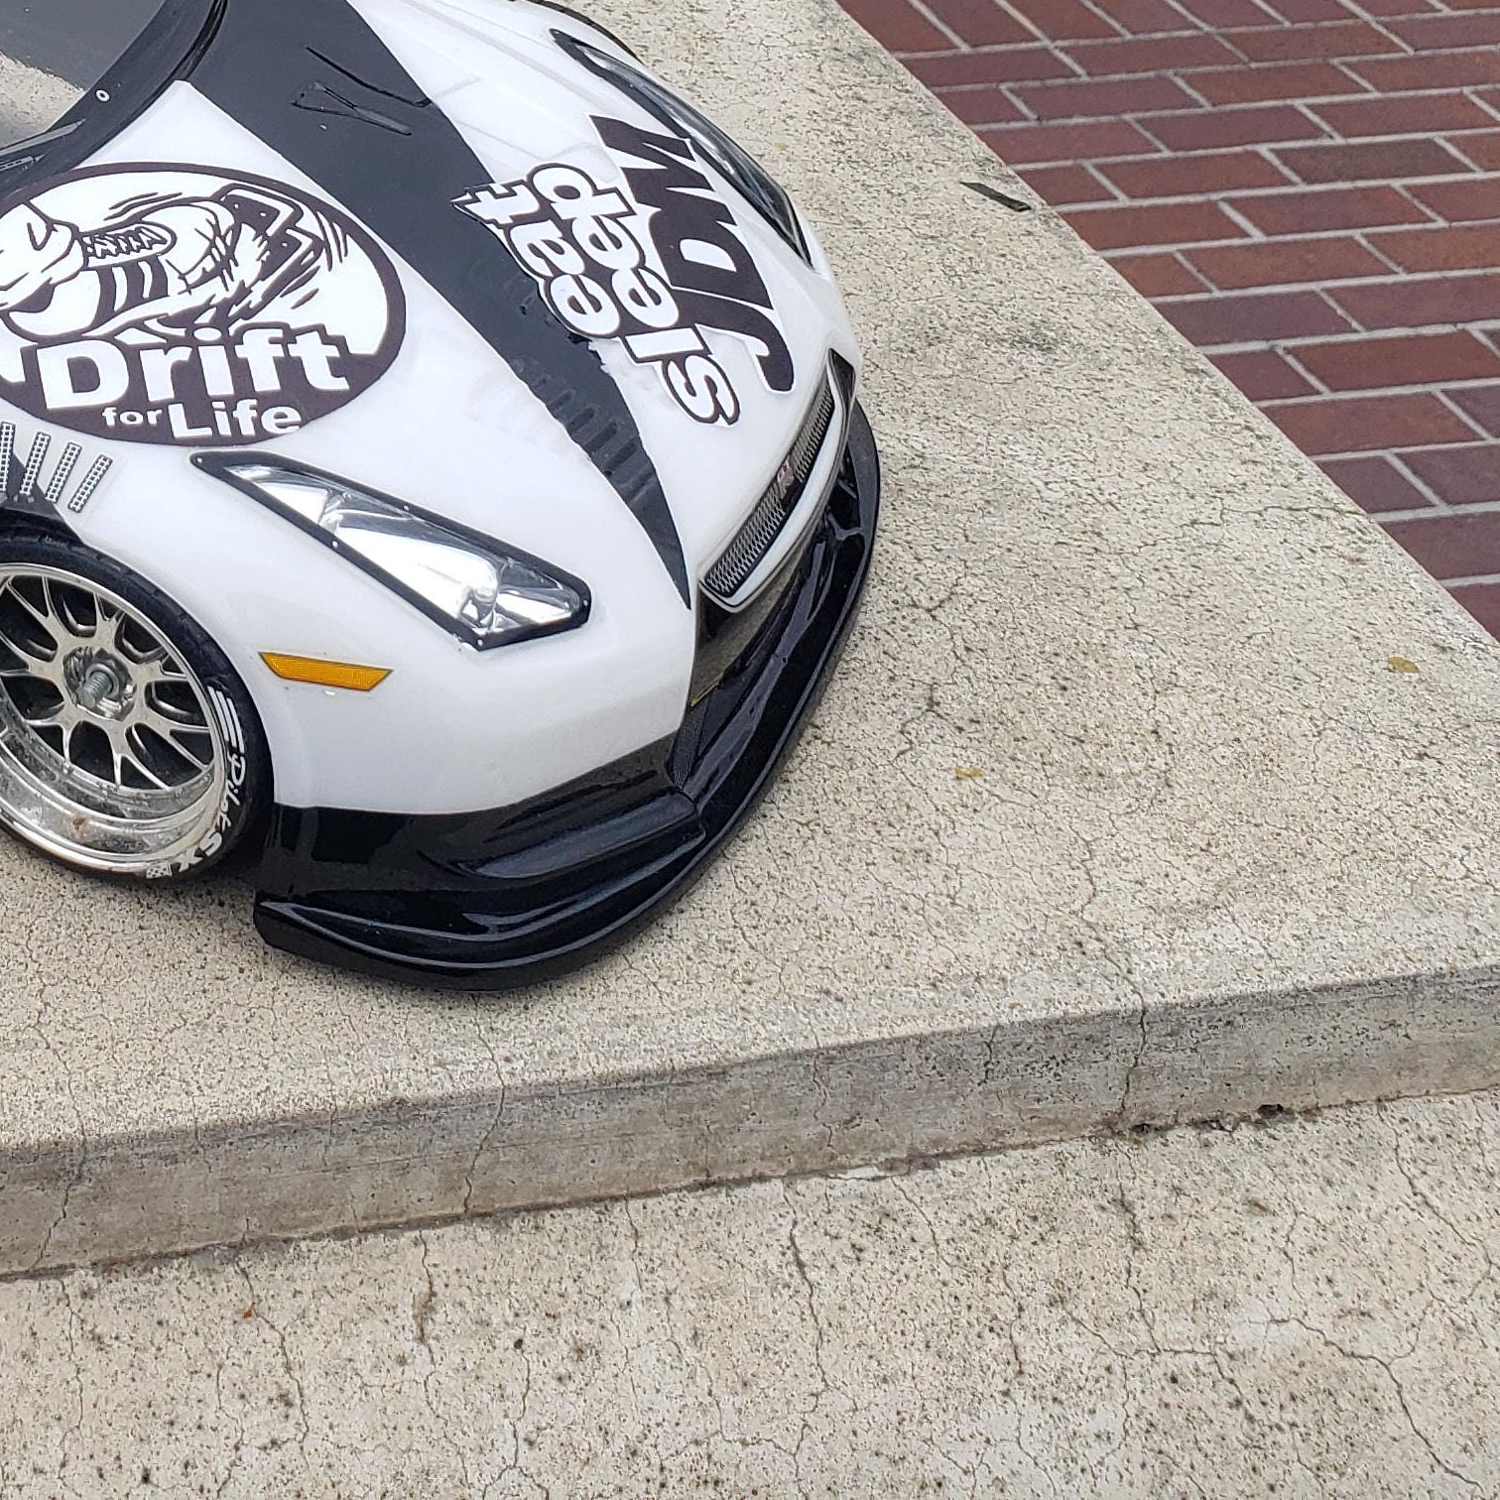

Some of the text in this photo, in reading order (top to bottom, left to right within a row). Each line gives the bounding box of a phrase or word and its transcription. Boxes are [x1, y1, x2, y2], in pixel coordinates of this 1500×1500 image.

[590, 115, 794, 391] JDM
[36, 325, 350, 410] Drift
[102, 399, 301, 438] for Life
[219, 747, 246, 832] Pilot
